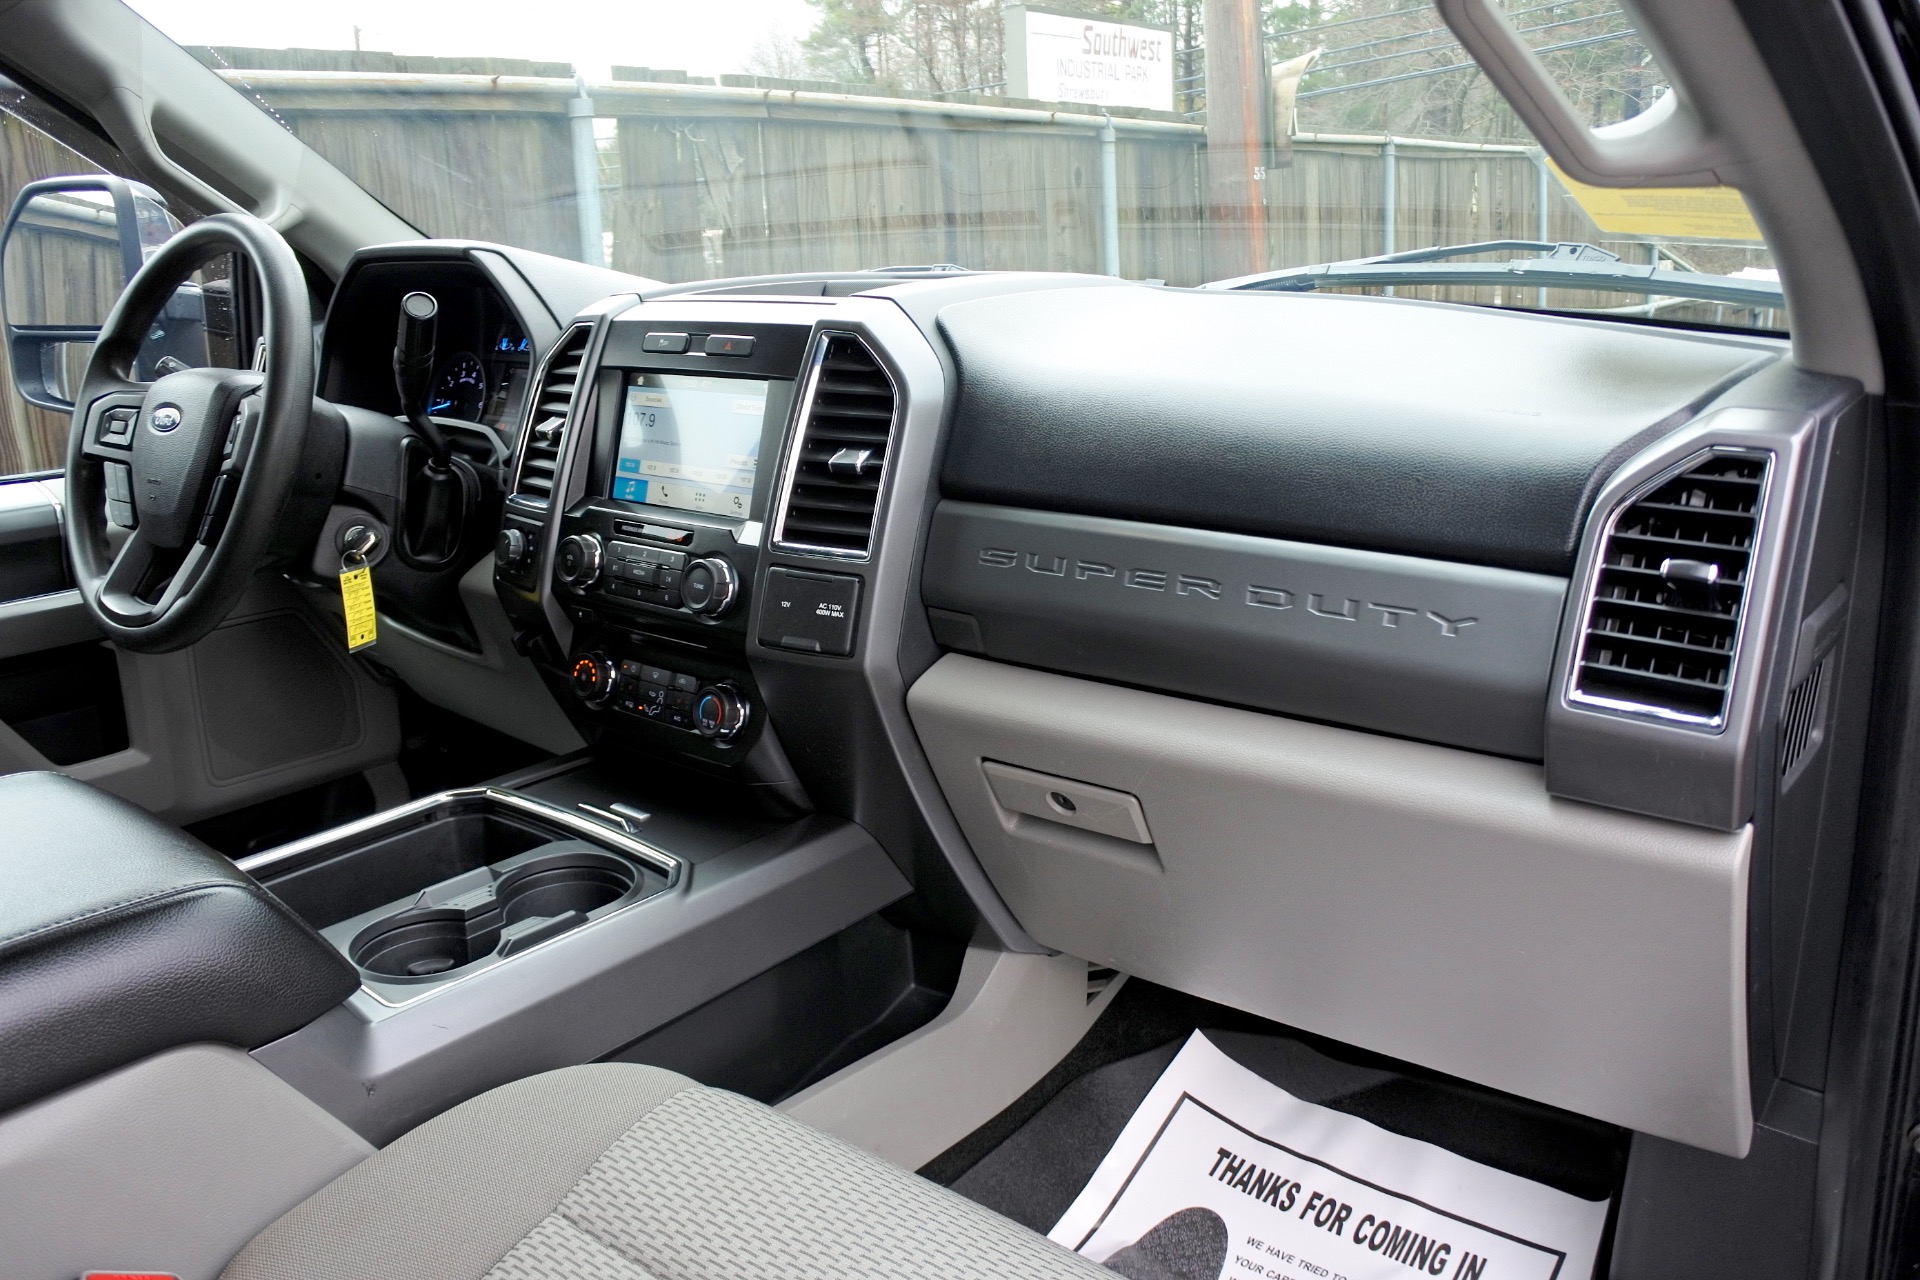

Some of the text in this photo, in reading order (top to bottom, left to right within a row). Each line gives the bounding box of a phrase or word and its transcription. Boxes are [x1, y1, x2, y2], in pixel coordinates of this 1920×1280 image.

[1081, 25, 1162, 62] Southwest
[1056, 58, 1150, 83] INDUSTRIAL PARK
[1058, 82, 1110, 101] Shrewsbury
[1253, 166, 1266, 180] 55
[978, 547, 1478, 638] SUPER DUTY
[818, 602, 842, 611] AC 110V
[831, 610, 844, 618] MAX
[1208, 1147, 1488, 1280] THANKS FOR COMING IN
[1234, 1255, 1265, 1275] YOUR
[1246, 1236, 1264, 1251] WE
[1265, 1245, 1296, 1265] HAVE
[1297, 1259, 1330, 1278] TRIED
